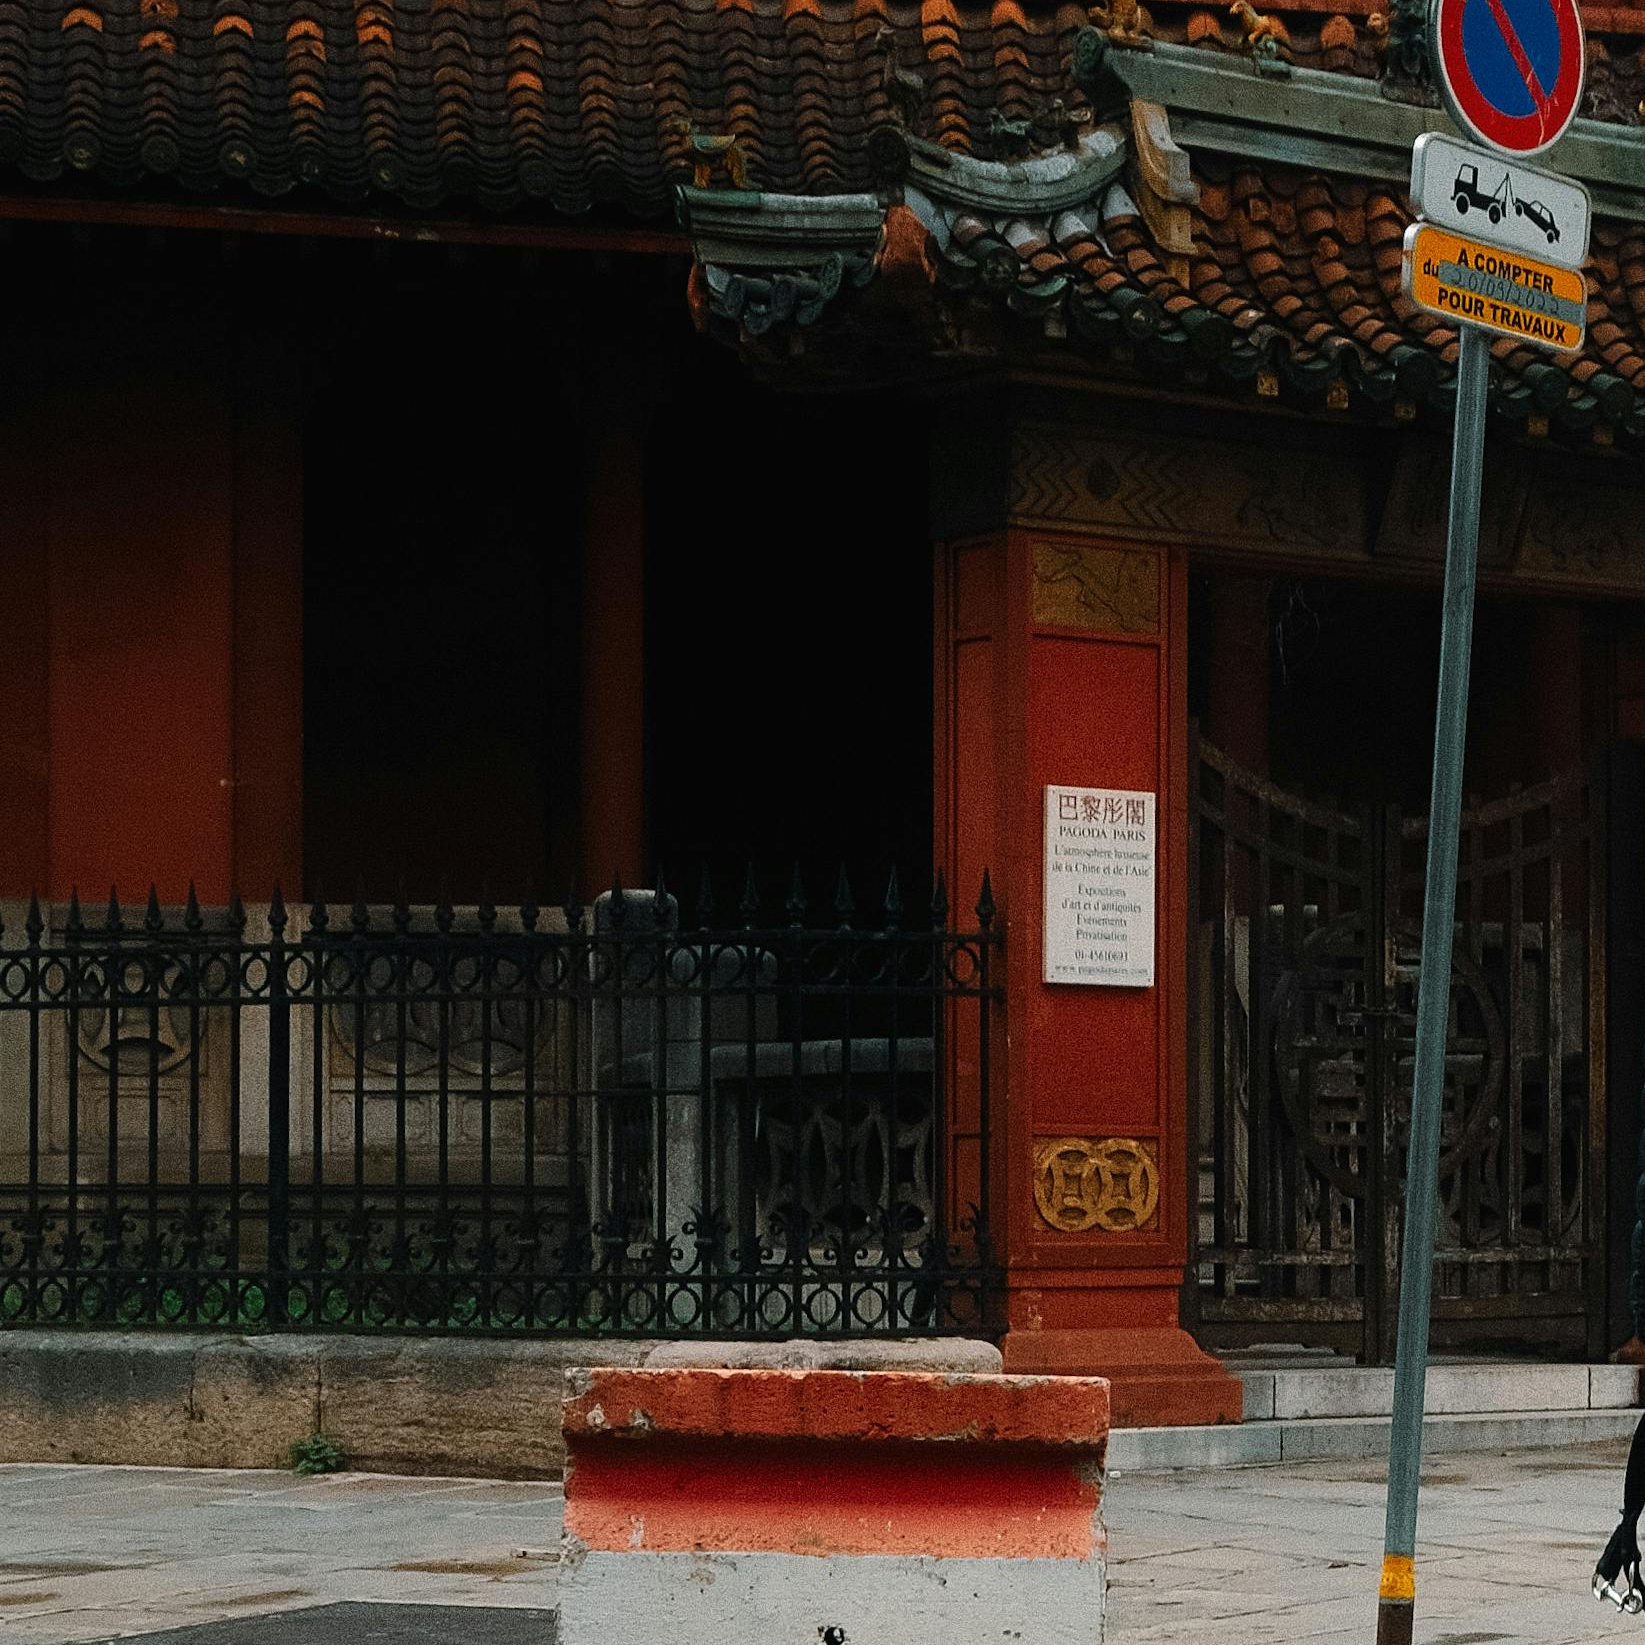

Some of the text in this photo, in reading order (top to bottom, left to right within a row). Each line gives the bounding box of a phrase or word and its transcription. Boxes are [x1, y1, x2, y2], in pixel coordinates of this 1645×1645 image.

[1423, 258, 1440, 277] du
[1457, 248, 1554, 294] A COMPTER
[1438, 287, 1566, 342] POUR TRAVAUX
[1059, 826, 1146, 841] PAGODA PARIS
[1052, 861, 1061, 872] de
[1075, 862, 1100, 874] Chine
[1103, 865, 1111, 875] et
[1113, 865, 1124, 875] de
[1083, 901, 1091, 910] et
[1076, 928, 1127, 941] Privatisation
